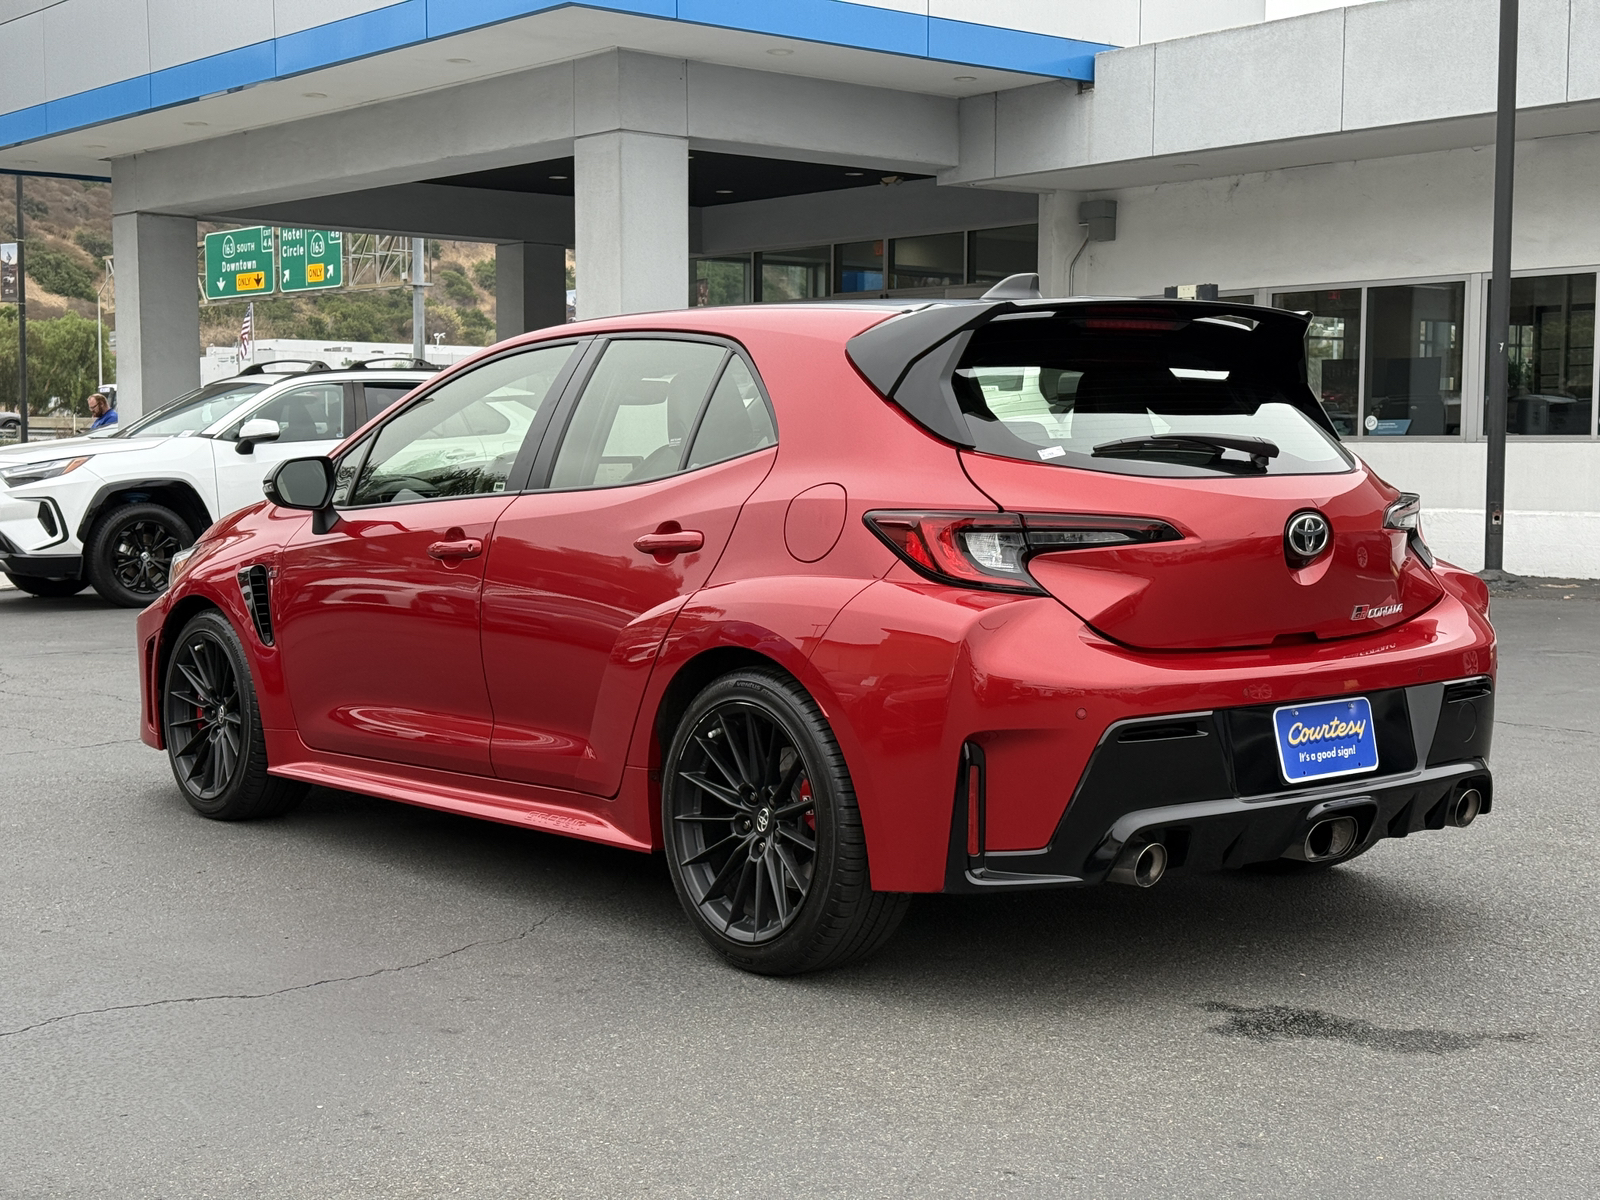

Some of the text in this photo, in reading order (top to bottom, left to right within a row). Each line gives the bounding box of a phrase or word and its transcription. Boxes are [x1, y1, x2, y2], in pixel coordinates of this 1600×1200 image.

[282, 228, 303, 241] Hotel
[224, 242, 255, 255] 163 SOUTH
[263, 238, 272, 247] 4A
[312, 241, 323, 253] 163
[282, 244, 304, 258] Circle
[221, 259, 257, 272] Downtown
[309, 268, 323, 278] ONLY
[237, 277, 251, 287] ONLY
[1288, 716, 1366, 746] Courtesy
[1299, 752, 1310, 762] It's
[1317, 747, 1336, 762] good
[1337, 744, 1356, 759] sign!
